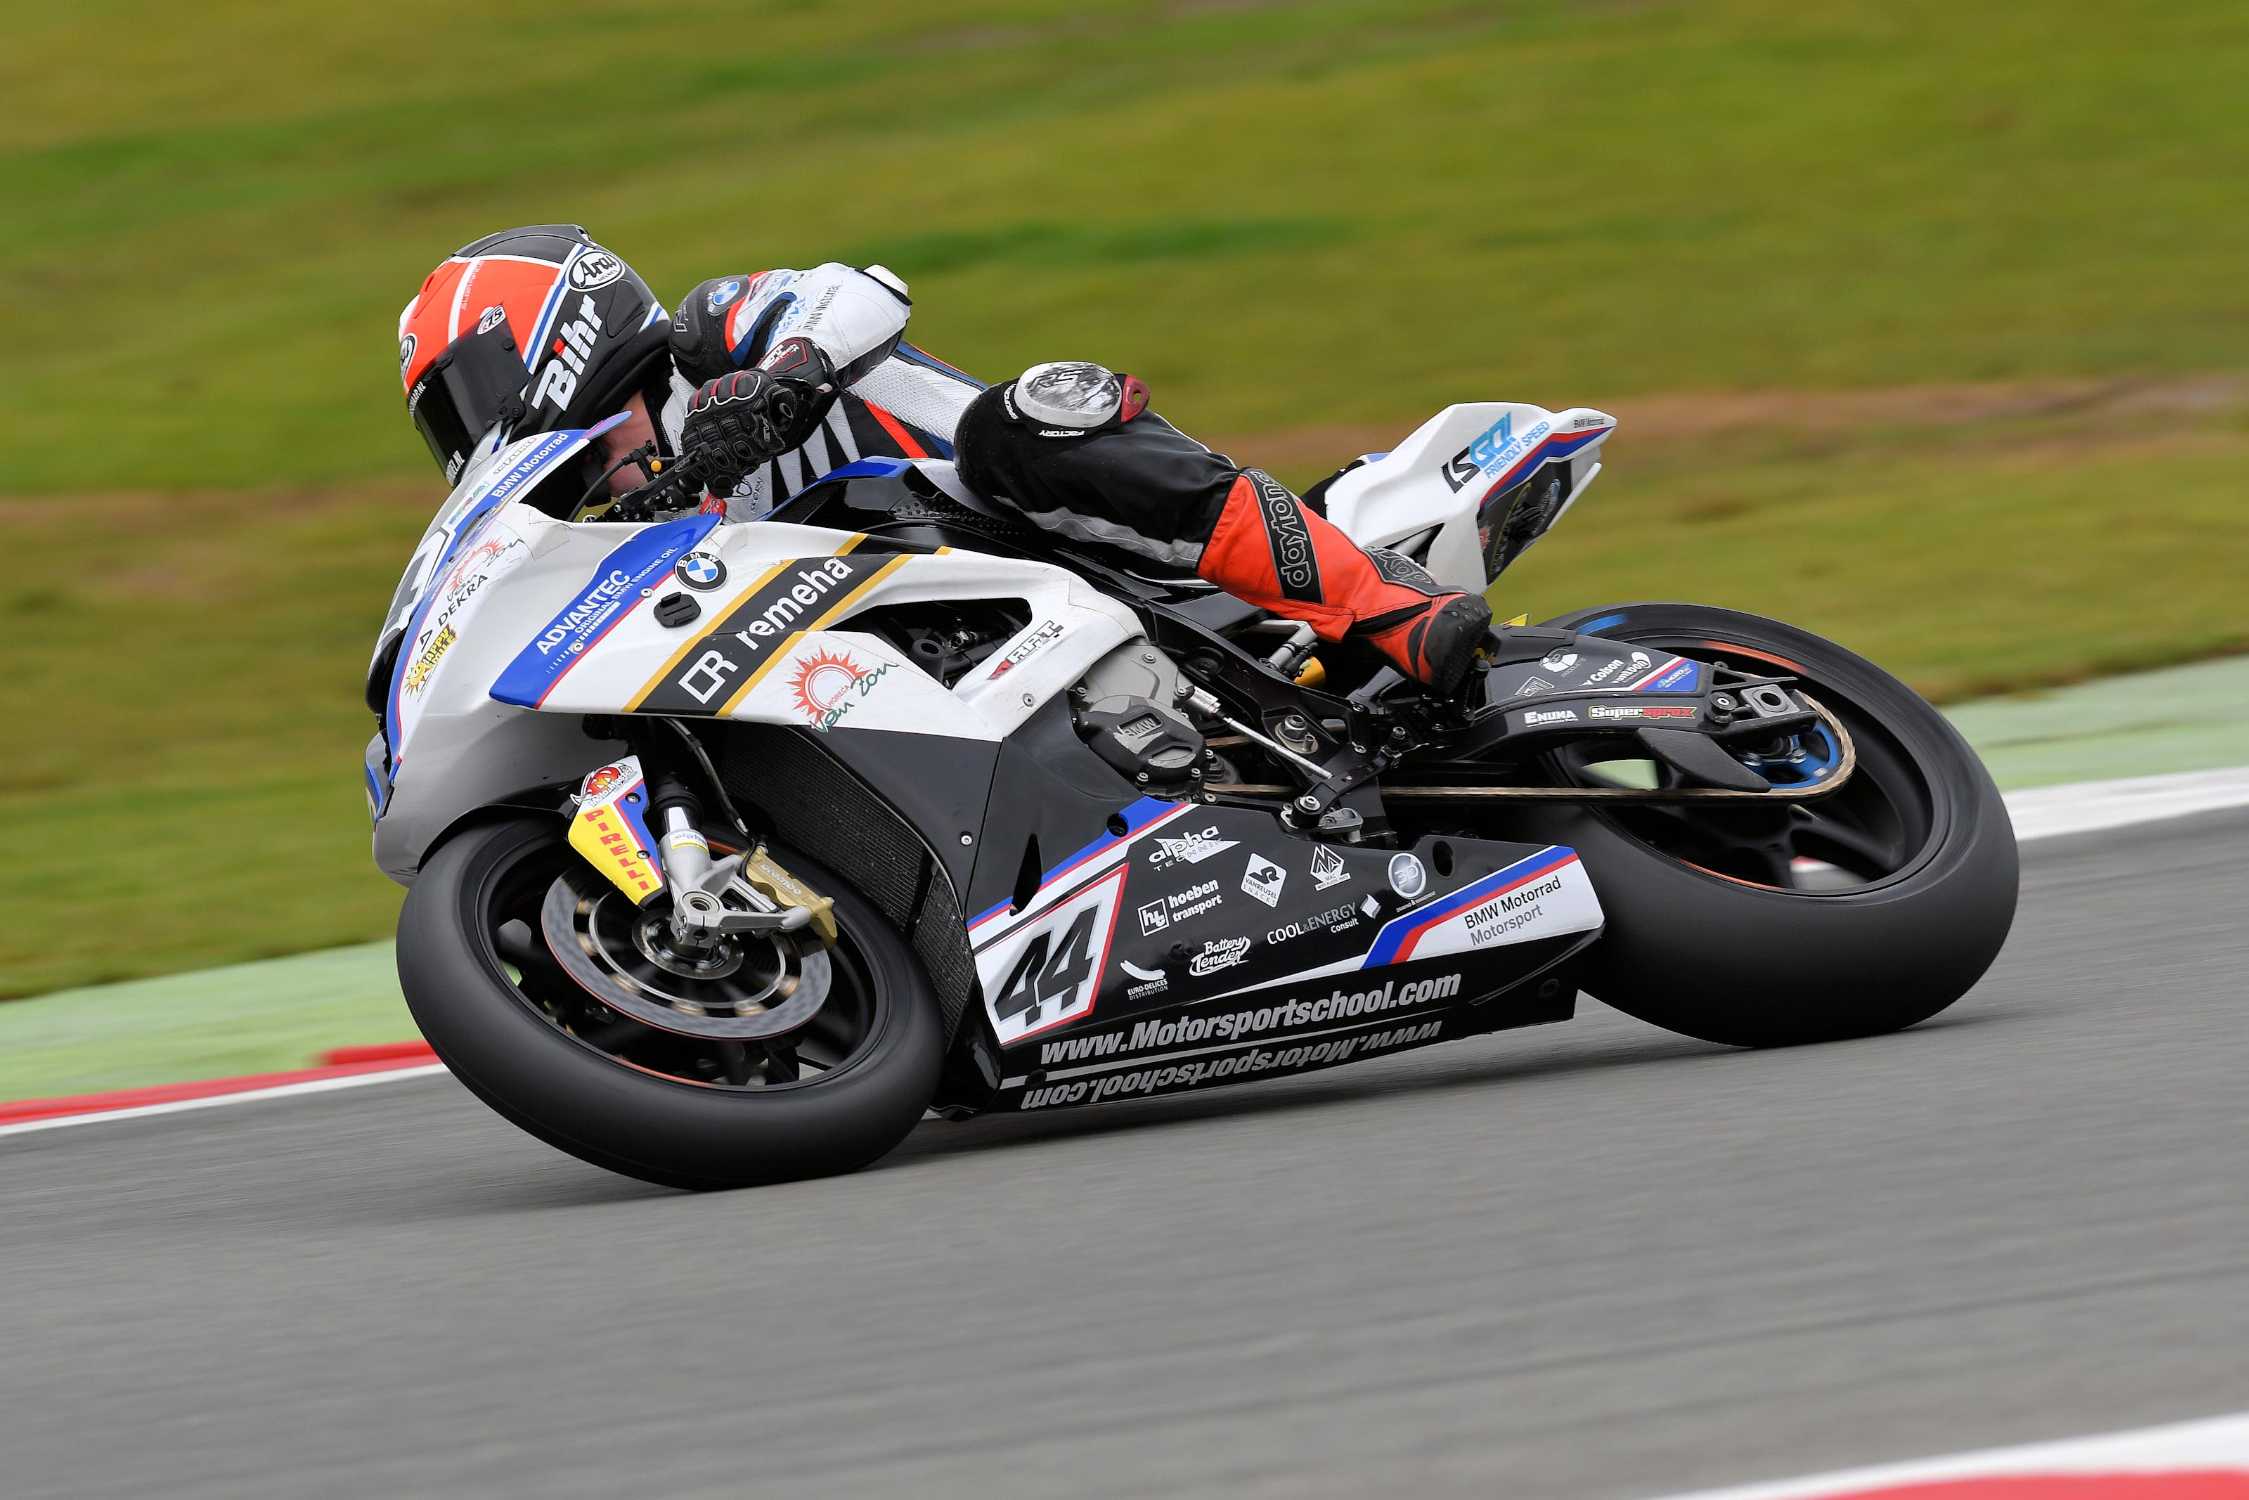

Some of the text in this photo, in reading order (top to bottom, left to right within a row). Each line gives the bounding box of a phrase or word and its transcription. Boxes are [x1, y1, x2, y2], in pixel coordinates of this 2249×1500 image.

[531, 294, 603, 411] Bihr
[491, 471, 523, 499] BMW
[521, 433, 569, 473] Motorrad
[1485, 420, 1550, 478] FRIENDLY SPEED
[438, 574, 488, 627] DEKRA
[536, 569, 631, 656] ADVANTEC
[574, 546, 679, 634] ORIGINAL BMW ENGINE OIL
[735, 556, 854, 650] remeha
[1591, 659, 1625, 683] Colson
[1524, 710, 1577, 725] ENUMA
[584, 809, 650, 890] PIRELLI
[1149, 825, 1220, 863] alpha
[1168, 879, 1220, 908] hoeben
[1172, 894, 1223, 923] transport
[1464, 876, 1562, 930] BMW Motorrad
[1203, 936, 1247, 955] Battery
[1330, 918, 1359, 934] Consult
[1470, 904, 1543, 947] Motorsport
[995, 904, 1099, 1028] 44
[1127, 978, 1168, 996] EURO-DELICES
[1190, 949, 1244, 975] Tender
[1040, 973, 1461, 1065] www.Motorsportschool.com
